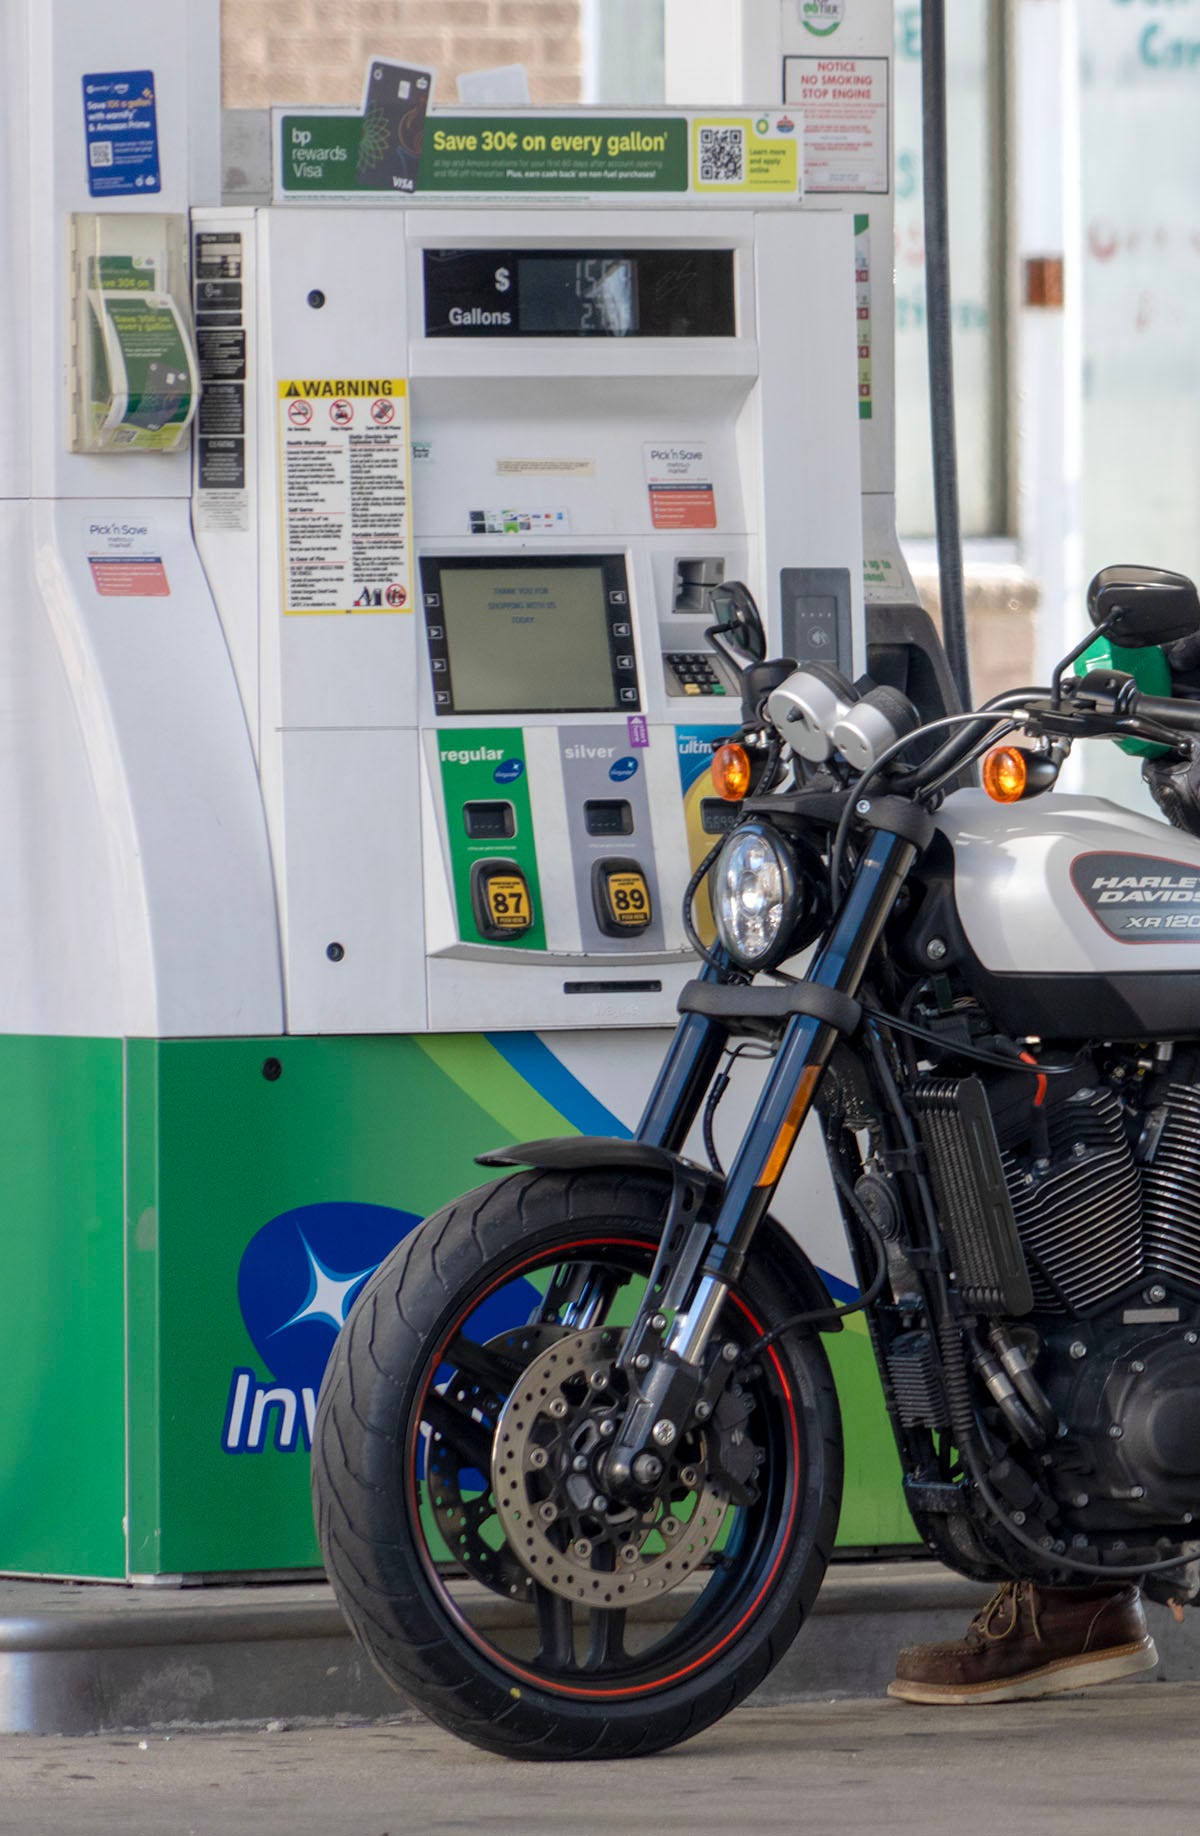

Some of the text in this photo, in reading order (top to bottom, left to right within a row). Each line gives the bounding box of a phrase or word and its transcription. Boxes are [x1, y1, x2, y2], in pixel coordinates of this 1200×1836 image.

[816, 61, 856, 72] NOTICE
[800, 74, 872, 86] NO SMOKING
[802, 88, 871, 99] STOP ENGINE
[291, 128, 311, 146] bp
[433, 131, 477, 151] Save
[481, 131, 517, 151] 30¢
[522, 135, 546, 151] on
[551, 135, 601, 156] every
[291, 146, 347, 161] rewards
[293, 163, 323, 178] Visa
[392, 176, 414, 190] VISA
[494, 267, 511, 291] $
[449, 307, 511, 325] Gallons
[302, 380, 393, 397] WARNING
[679, 449, 703, 460] Save
[121, 524, 148, 535] Save
[440, 747, 504, 764] regular
[564, 745, 614, 759] silver
[493, 893, 523, 914] 87
[614, 889, 645, 911] 89
